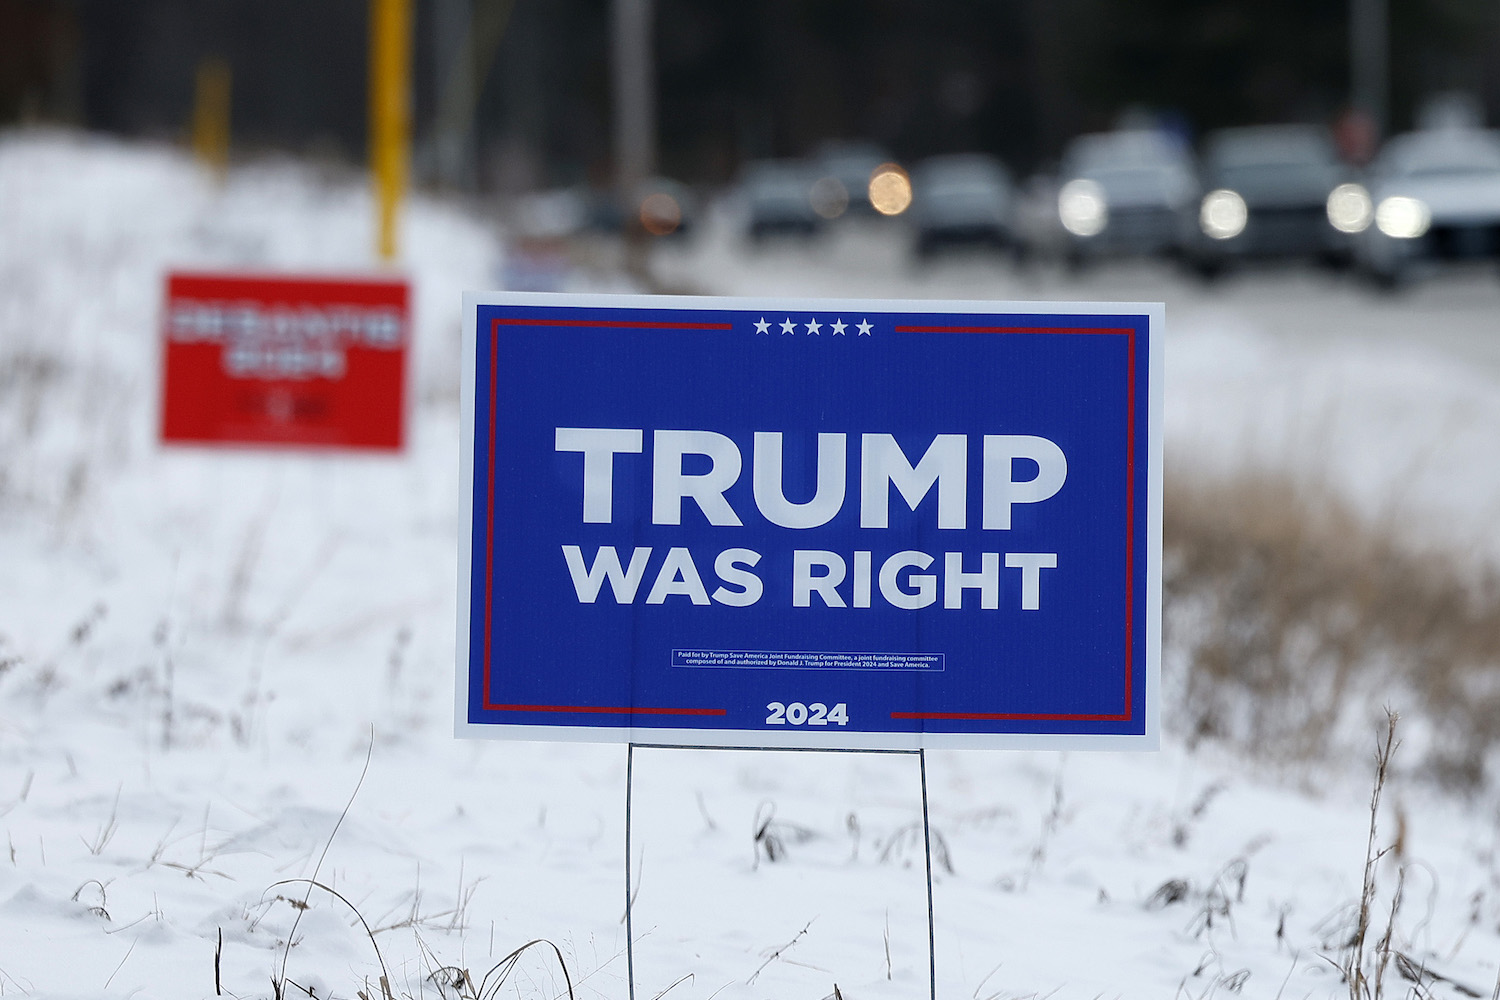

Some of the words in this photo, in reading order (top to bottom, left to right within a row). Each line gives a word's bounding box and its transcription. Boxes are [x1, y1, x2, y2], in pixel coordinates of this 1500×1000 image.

[554, 427, 1068, 531] TRUMP
[561, 544, 764, 607] WAS
[792, 549, 1058, 611] RIGHT
[710, 652, 729, 660] Trump
[765, 701, 849, 726] 2024
